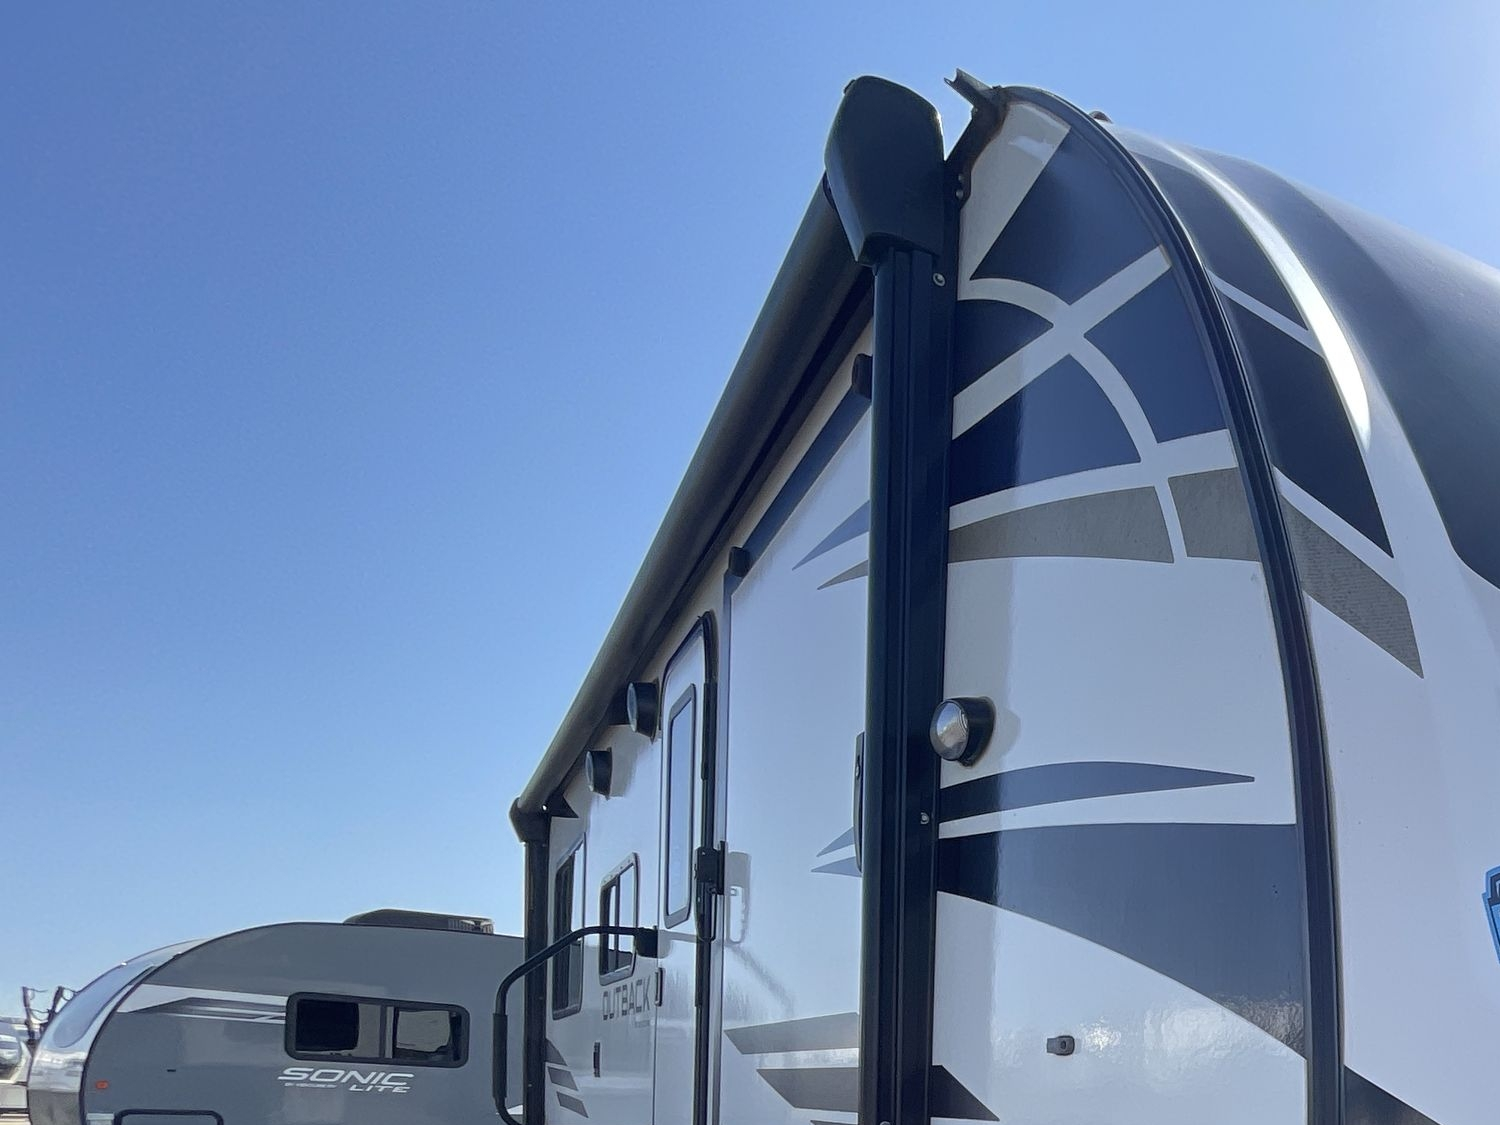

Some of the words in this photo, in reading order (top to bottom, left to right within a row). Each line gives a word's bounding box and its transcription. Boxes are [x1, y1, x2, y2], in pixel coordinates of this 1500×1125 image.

[602, 975, 652, 1021] OUTBACK
[277, 1067, 415, 1086] SONIC
[348, 1084, 411, 1093] LITE
